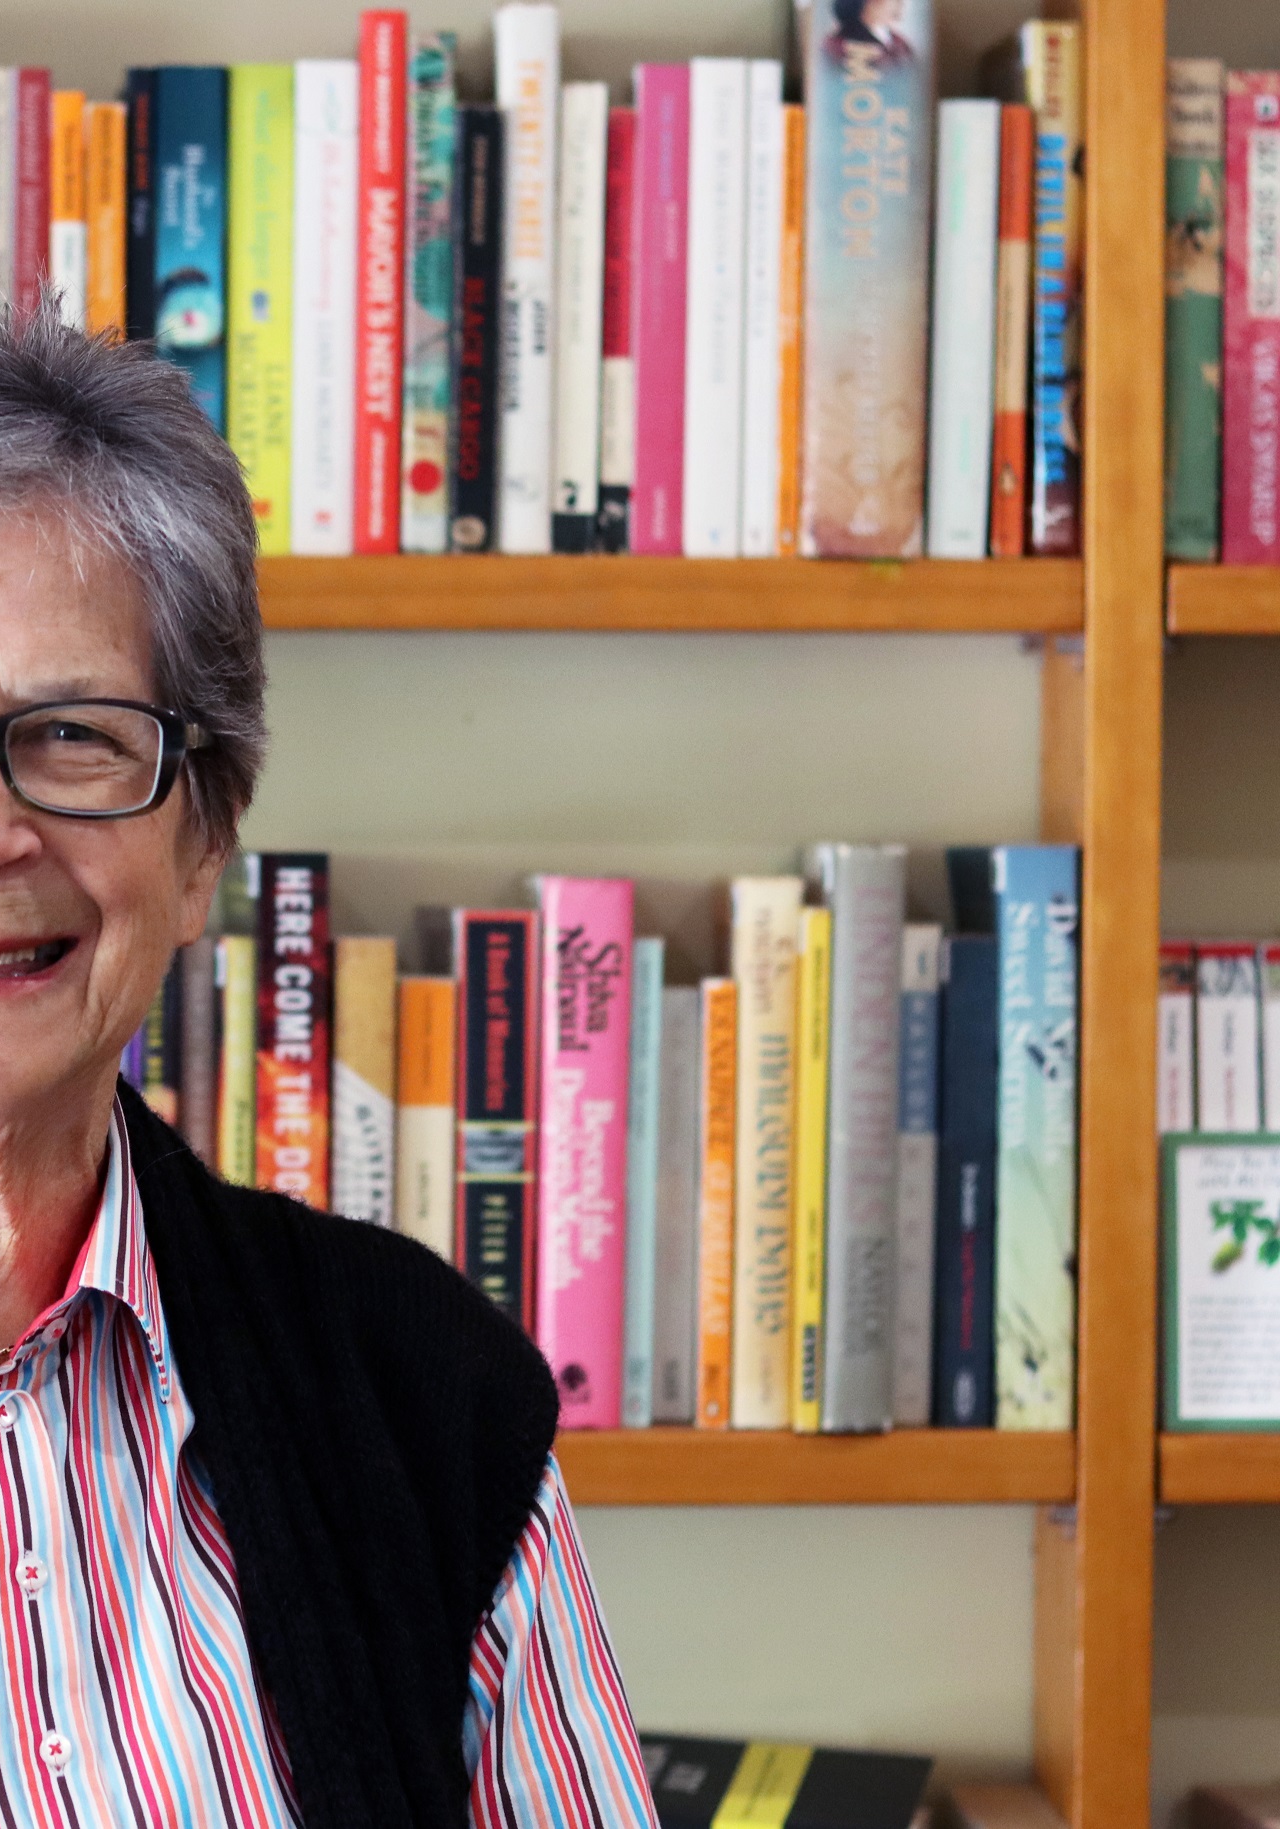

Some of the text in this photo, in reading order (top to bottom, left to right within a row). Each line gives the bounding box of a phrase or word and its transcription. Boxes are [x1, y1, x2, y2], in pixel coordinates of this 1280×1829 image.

[163, 165, 182, 226] Secret
[181, 143, 207, 250] Husband's
[513, 59, 545, 261] TWENTY-THREE
[840, 40, 883, 260] MORTON
[884, 106, 911, 197] KATE
[365, 187, 399, 420] MAYOR'S NEST
[462, 277, 485, 482] BLACK CARGO
[531, 299, 547, 357] JOHN
[1036, 134, 1066, 485] DEVIL IN A BLUE DRESS
[264, 364, 284, 448] LIANE
[274, 866, 314, 1200] HERE COME THE DO
[485, 932, 510, 1110] A Book of Memories
[555, 924, 588, 1053] Naipaul
[577, 941, 624, 1034] Shiva
[846, 885, 897, 1224] LINDEN HILLS
[1003, 900, 1037, 1151] Sweet Sorrow
[1042, 900, 1077, 1166] David Nicholls
[550, 1193, 584, 1290] Mouth
[574, 1099, 616, 1263] Beyond the
[746, 1033, 791, 1335] MALGUDI DAYS
[862, 1237, 889, 1353] NAYLOR
